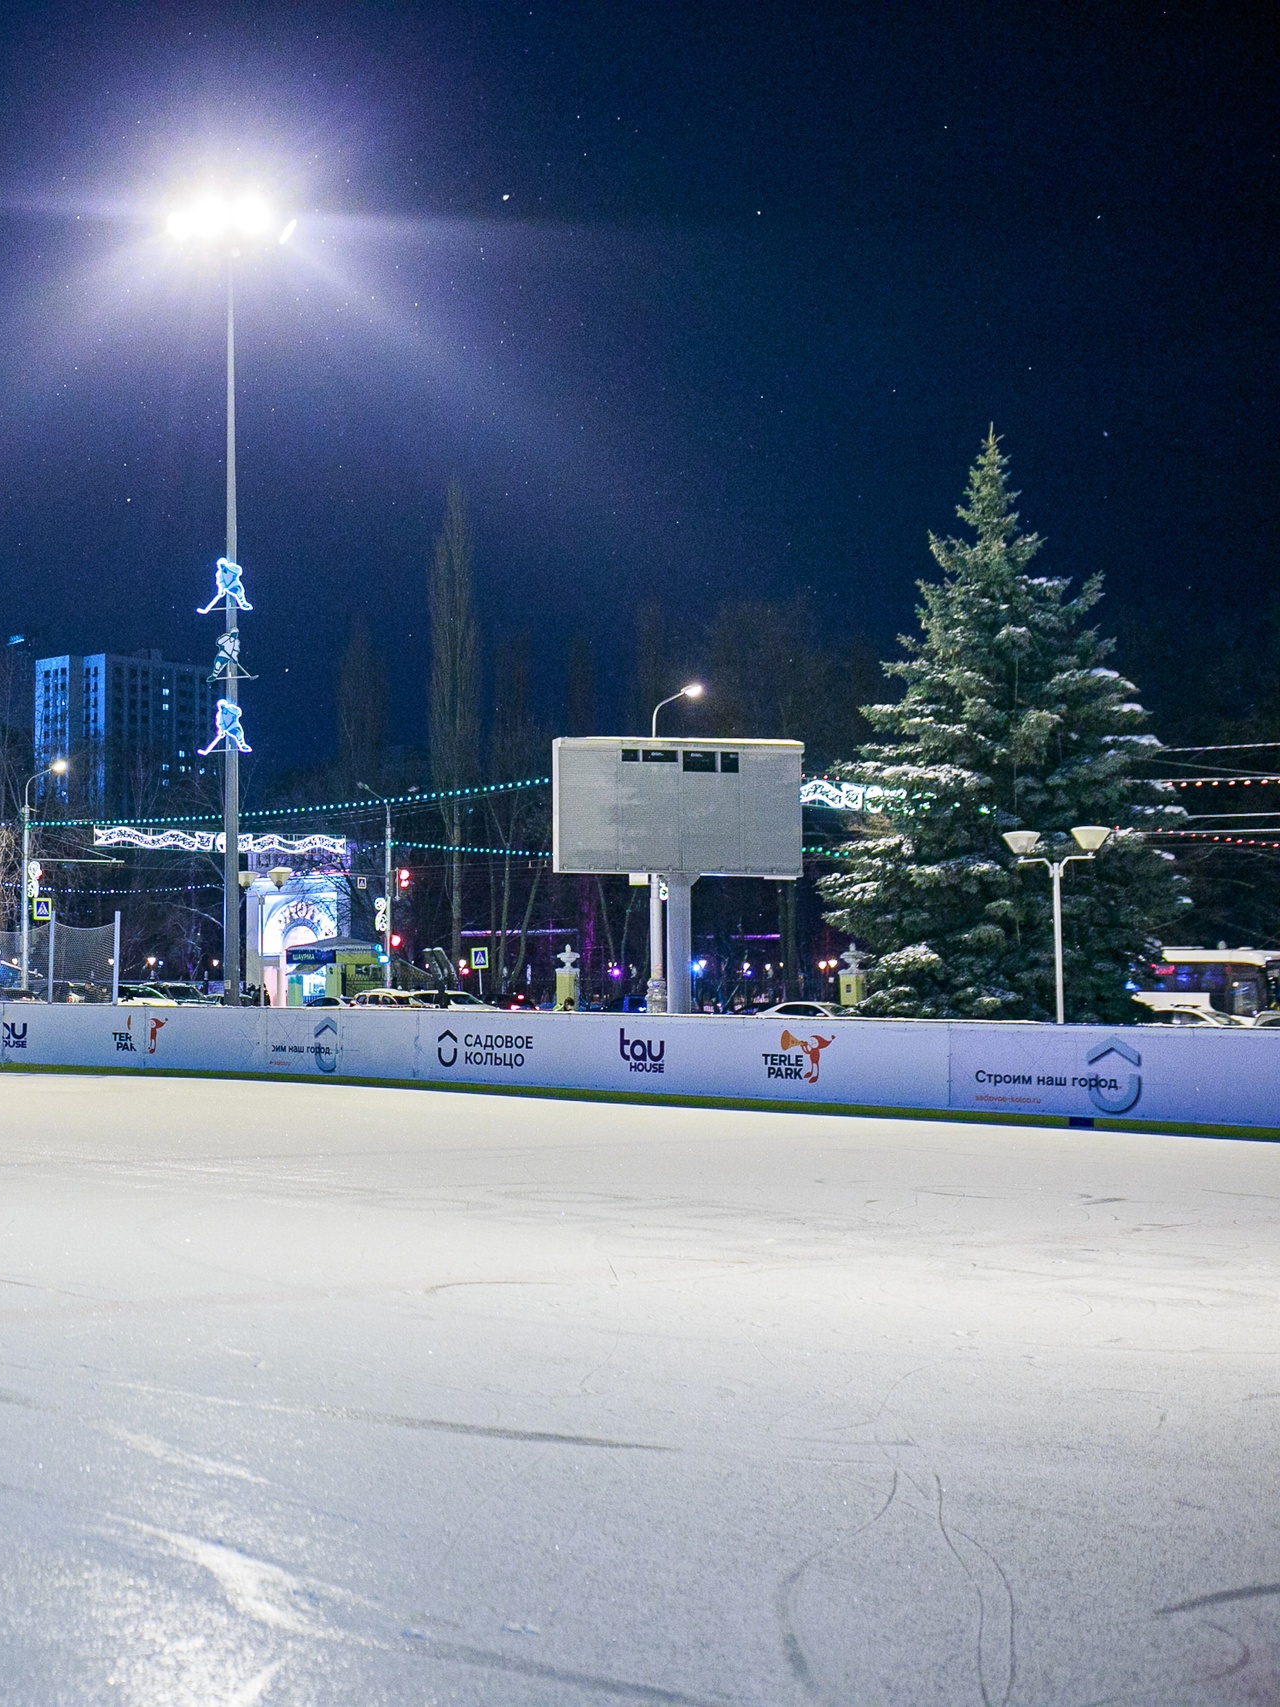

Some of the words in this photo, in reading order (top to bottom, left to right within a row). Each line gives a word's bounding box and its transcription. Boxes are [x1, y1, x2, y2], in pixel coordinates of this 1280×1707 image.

[292, 953, 315, 961] ШАУРМА
[464, 1034, 533, 1050] САДОВОЕ
[620, 1028, 665, 1062] tau
[464, 1052, 525, 1069] КОЛЬЦО
[629, 1062, 665, 1073] HOUSE
[762, 1053, 804, 1067] TERLE
[767, 1067, 803, 1080] PARK
[975, 1070, 1032, 1086] Строим
[1037, 1075, 1067, 1087] наш
[1072, 1076, 1122, 1091] город.
